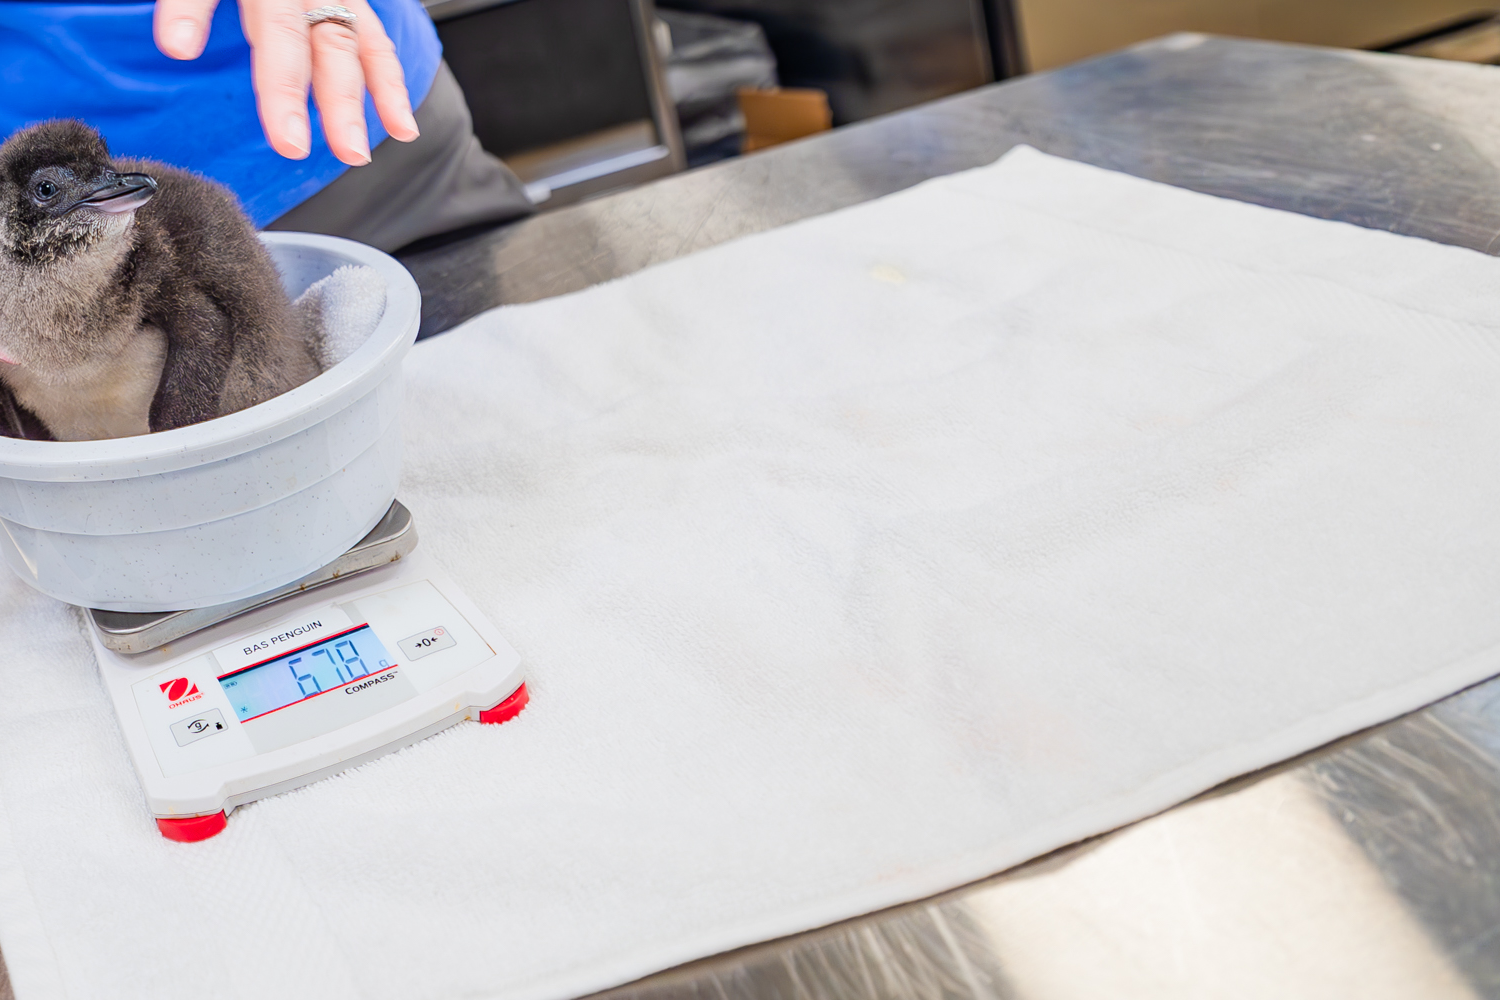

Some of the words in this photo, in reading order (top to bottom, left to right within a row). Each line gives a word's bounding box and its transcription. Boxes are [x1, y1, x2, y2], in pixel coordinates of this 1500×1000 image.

[243, 640, 269, 655] BAS
[270, 620, 323, 645] PENGUIN
[288, 640, 369, 699] 678
[168, 694, 203, 710] OHAUS
